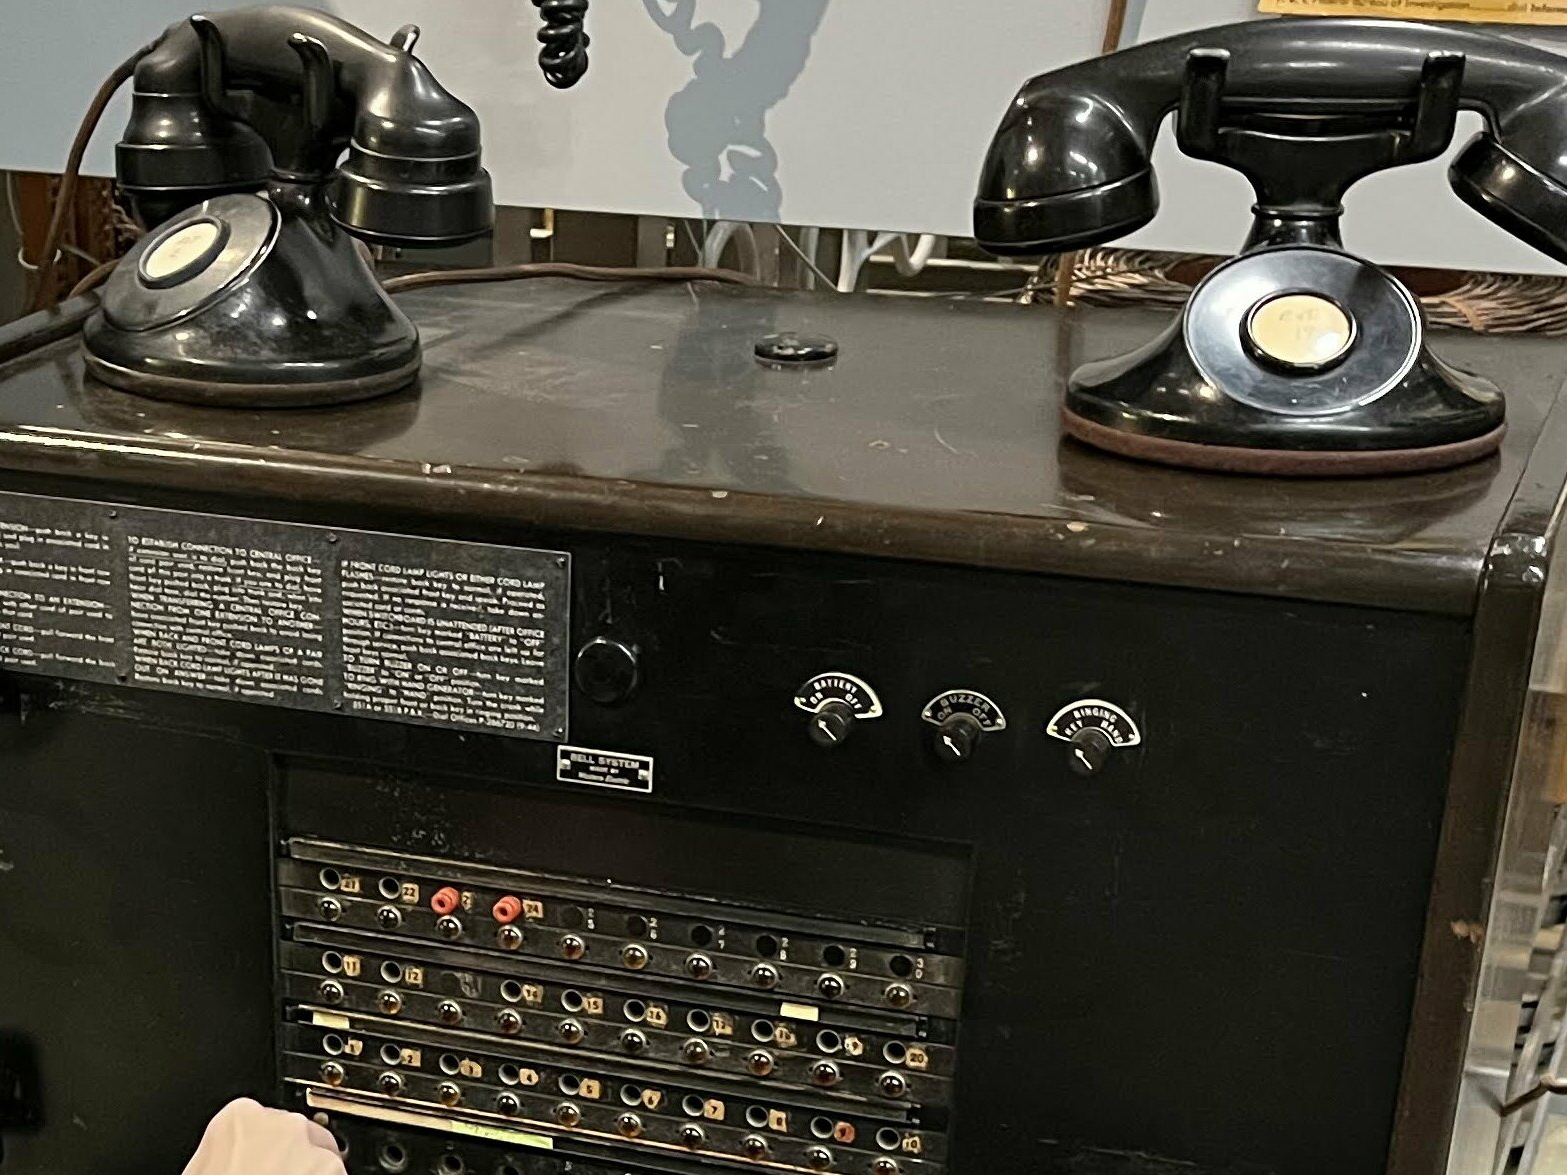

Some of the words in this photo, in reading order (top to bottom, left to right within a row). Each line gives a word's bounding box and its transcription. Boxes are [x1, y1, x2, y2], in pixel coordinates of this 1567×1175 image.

[127, 536, 139, 544] TO
[235, 548, 246, 556] TO
[939, 694, 991, 713] BUZZER
[937, 706, 953, 720] ON
[972, 707, 992, 726] OFF
[598, 757, 640, 769] SYSTEM
[402, 886, 417, 897] 22
[345, 961, 356, 973] 11
[585, 999, 597, 1010] 15
[908, 1053, 922, 1064] 20
